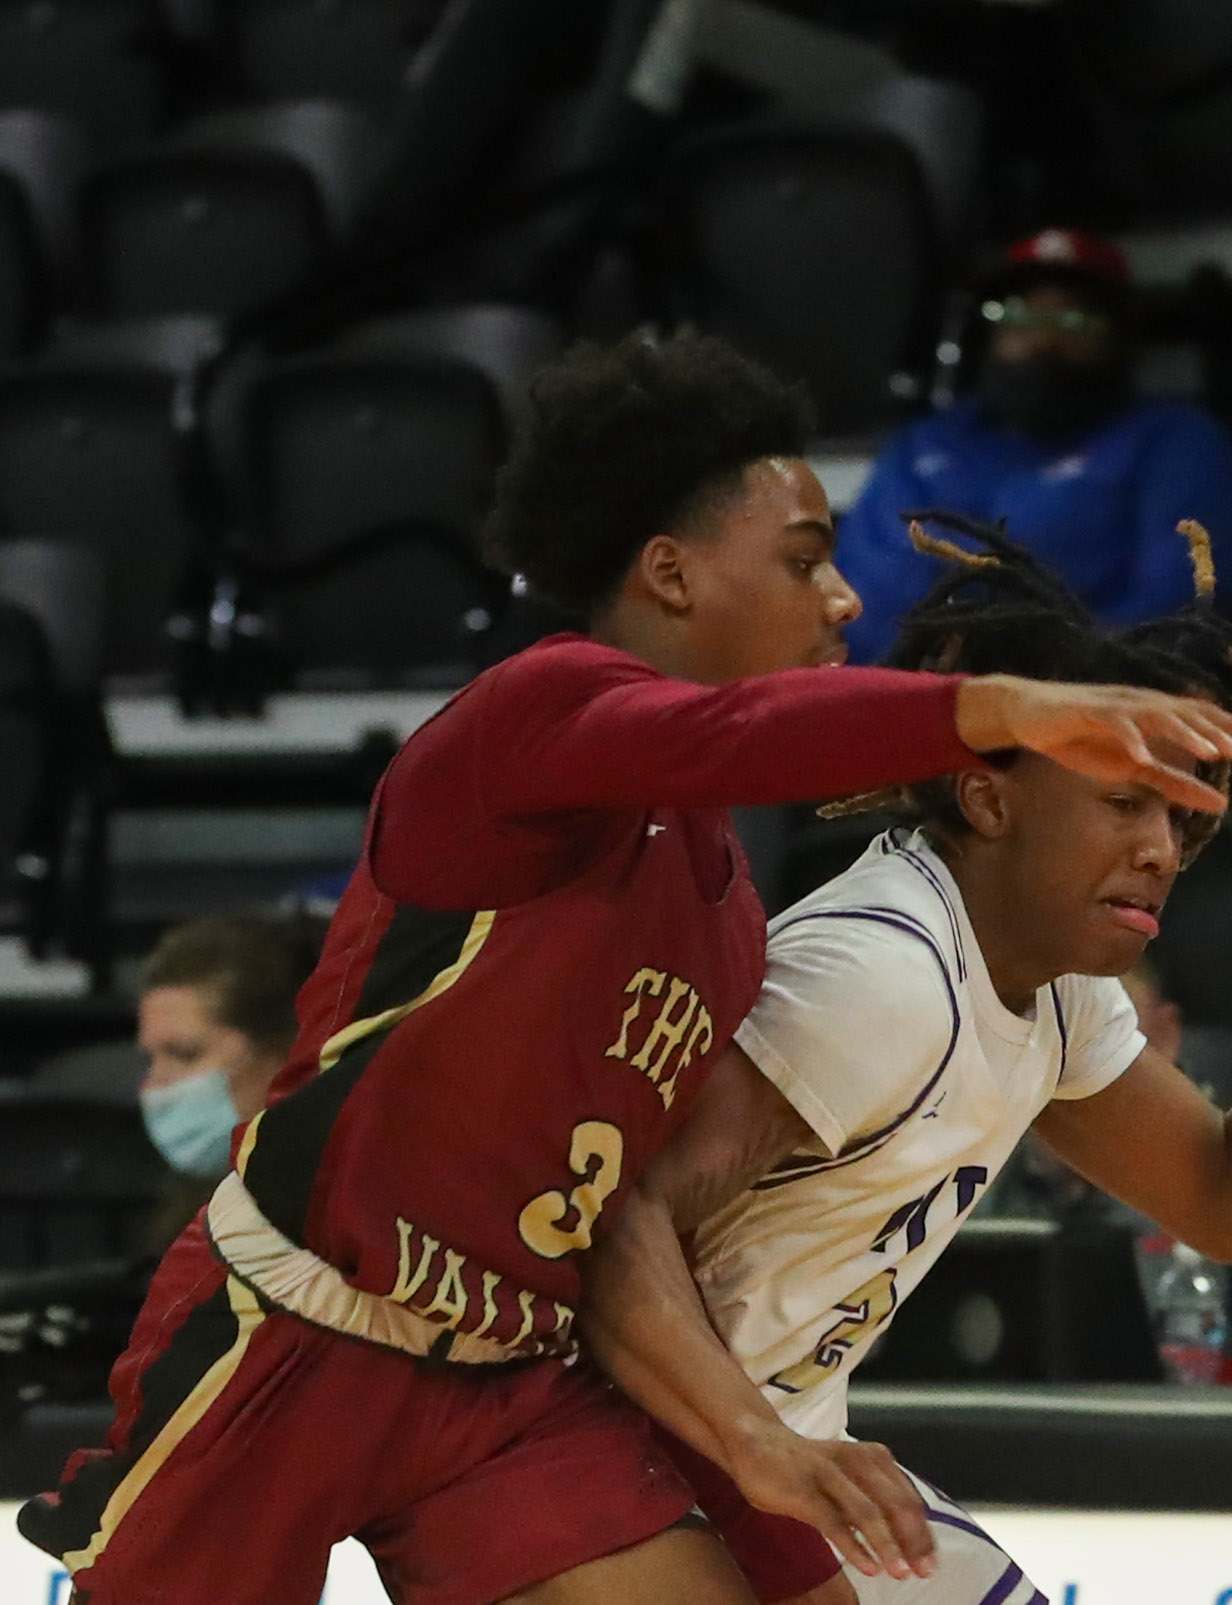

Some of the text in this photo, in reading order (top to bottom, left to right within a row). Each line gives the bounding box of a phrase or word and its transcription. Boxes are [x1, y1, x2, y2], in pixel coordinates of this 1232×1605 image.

[604, 967, 713, 1112] THE
[518, 1120, 624, 1259] 3
[390, 1216, 578, 1366] VALL
